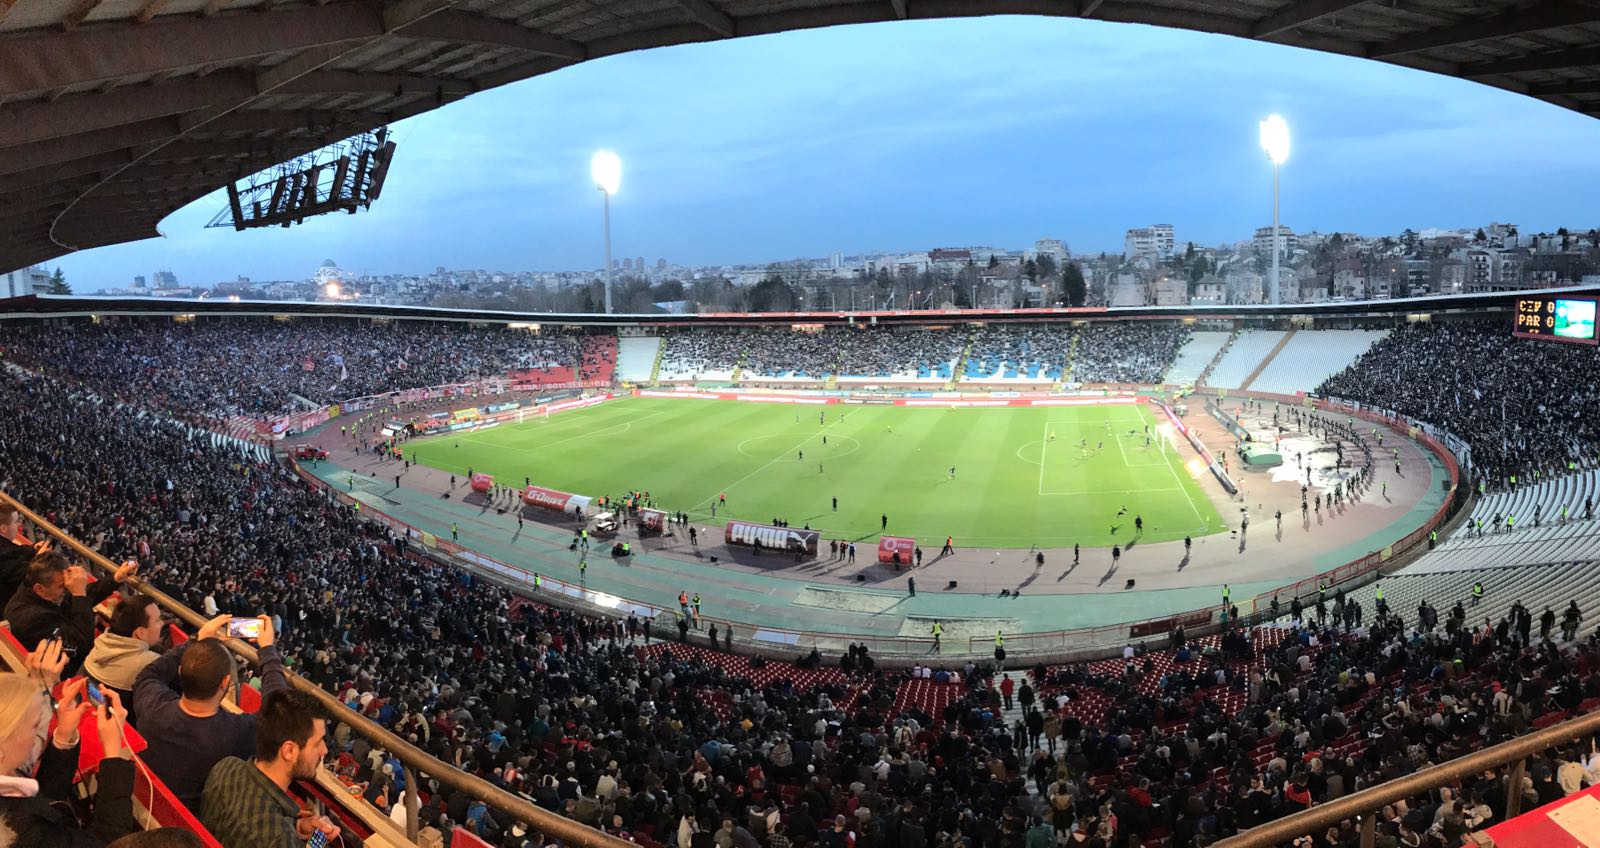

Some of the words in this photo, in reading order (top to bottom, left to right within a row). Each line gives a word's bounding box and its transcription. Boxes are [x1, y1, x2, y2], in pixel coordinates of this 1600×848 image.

[1547, 301, 1555, 314] 0
[1519, 314, 1541, 327] PAR
[1546, 315, 1554, 328] 0
[731, 523, 788, 549] PUMA
